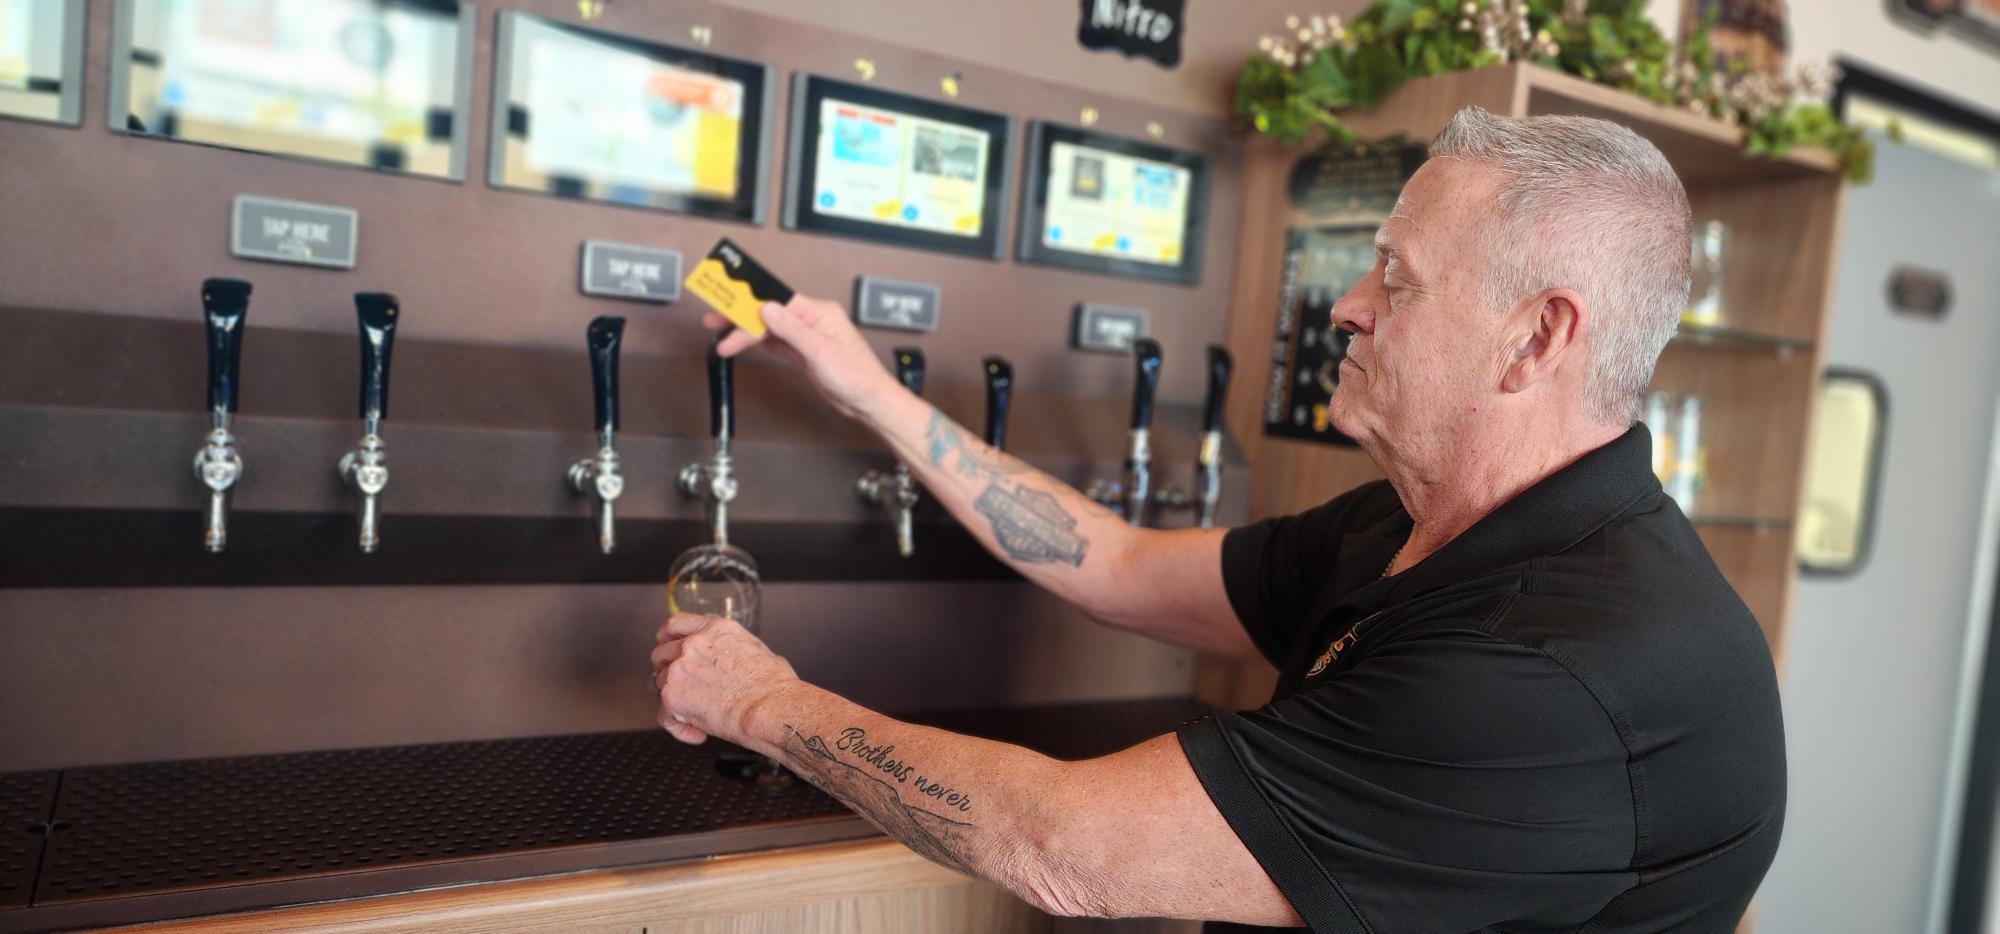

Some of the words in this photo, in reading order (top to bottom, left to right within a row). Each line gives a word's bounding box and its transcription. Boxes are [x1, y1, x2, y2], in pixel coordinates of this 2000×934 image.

[1091, 0, 1174, 42] Nitro
[263, 216, 290, 237] TAP
[292, 222, 329, 244] HERE
[835, 727, 915, 784] Brothers
[913, 774, 973, 812] never
